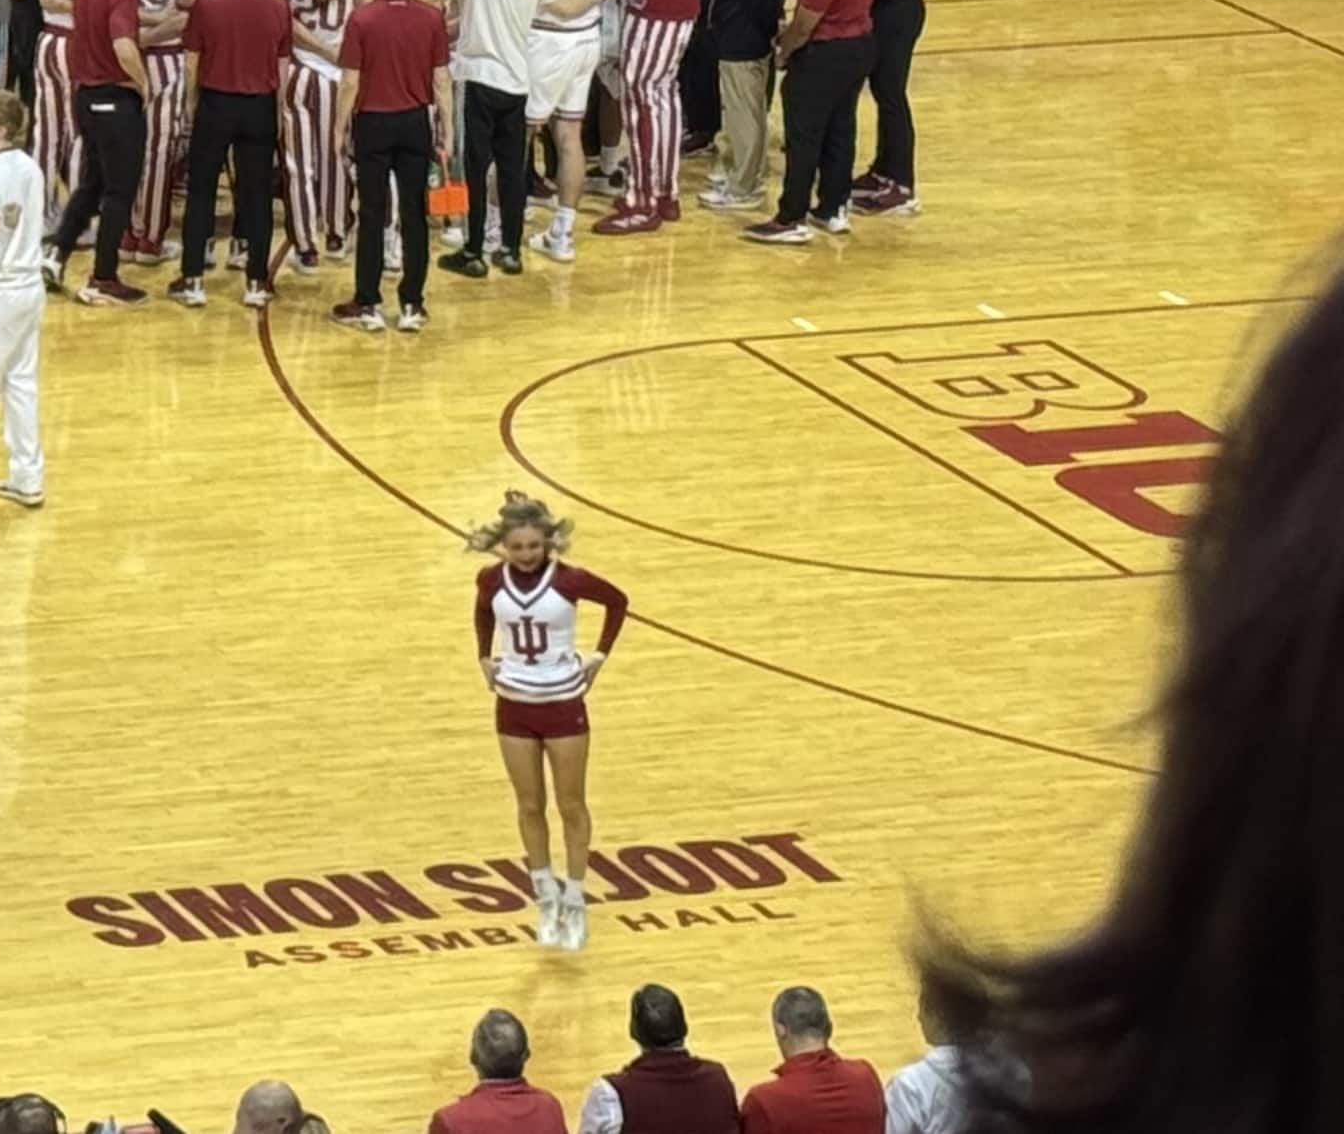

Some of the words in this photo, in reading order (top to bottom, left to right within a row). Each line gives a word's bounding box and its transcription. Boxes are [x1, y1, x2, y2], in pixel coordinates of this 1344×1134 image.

[505, 615, 549, 666] IU
[64, 868, 442, 949] SIMON
[243, 923, 539, 970] ASSEMB
[615, 900, 798, 935] HALL
